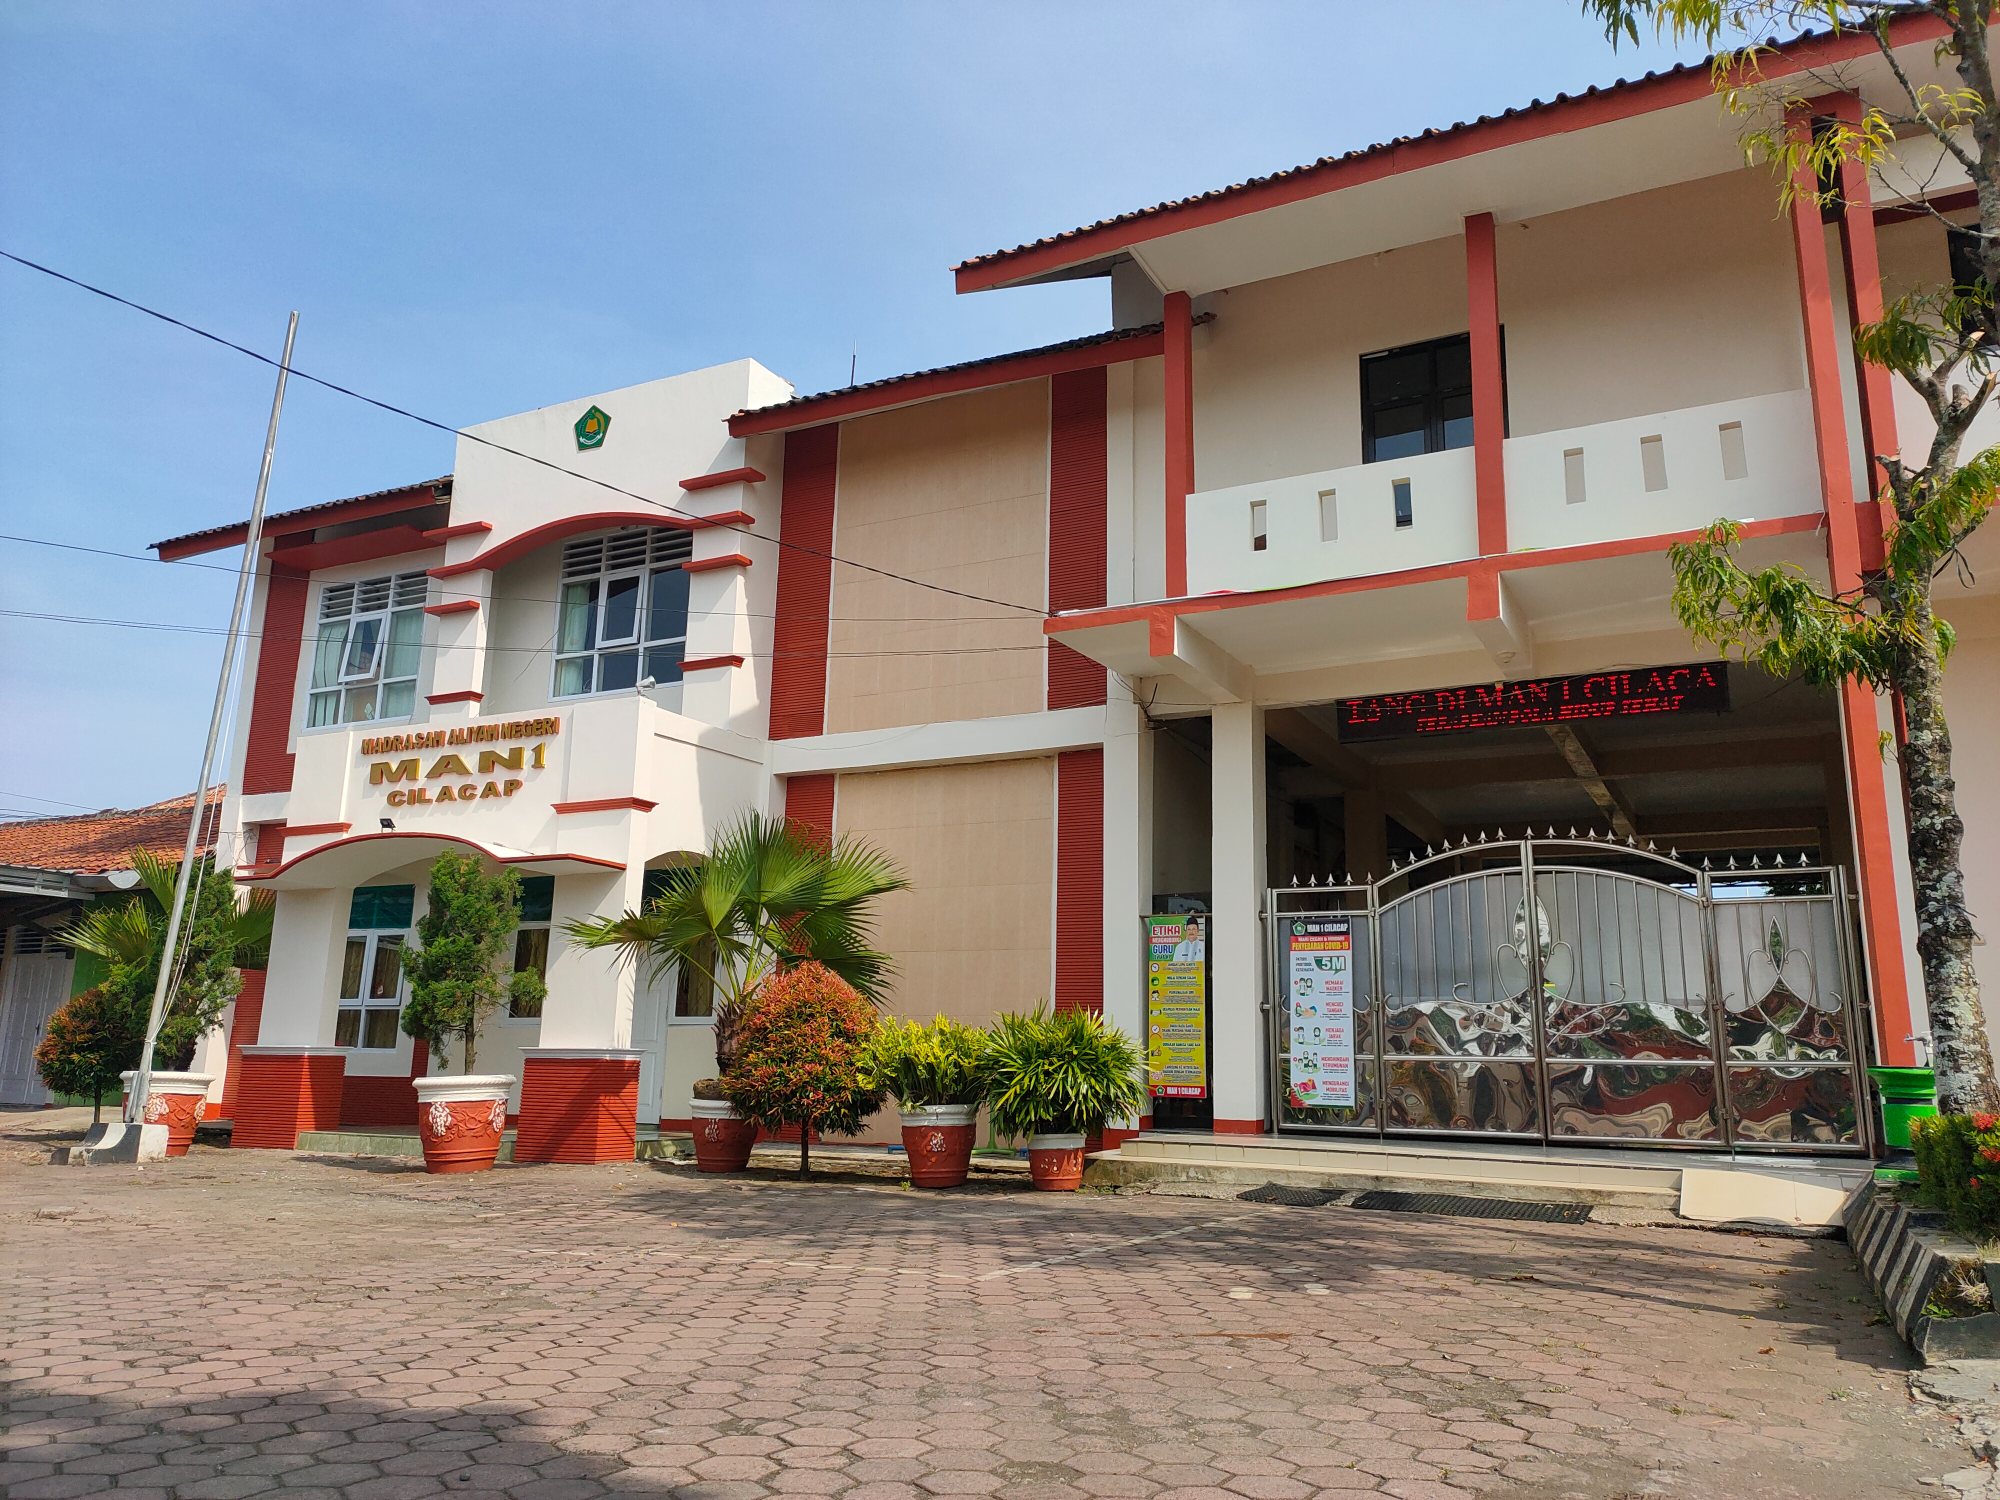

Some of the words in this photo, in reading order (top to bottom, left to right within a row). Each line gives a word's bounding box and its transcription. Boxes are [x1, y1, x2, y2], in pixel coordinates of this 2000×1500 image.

[1435, 690, 1466, 711] DI
[1475, 682, 1549, 708] MAN
[1621, 695, 1685, 714] SEHAT
[361, 731, 447, 755] MADRASAH
[447, 724, 500, 745] ALIYAH
[501, 717, 561, 740] NEGERI
[369, 747, 525, 784] MAN
[532, 742, 546, 769] 1
[387, 779, 524, 807] CILACAP
[1152, 925, 1181, 936] ETIKA
[1307, 924, 1320, 933] MAN
[1325, 923, 1349, 932] CILACAP
[1152, 944, 1174, 954] GURU
[1292, 942, 1324, 950] PENYEBARAN
[1325, 941, 1349, 950] COVID-19
[1321, 956, 1345, 971] 5M
[1181, 1087, 1201, 1095] CILACAP
